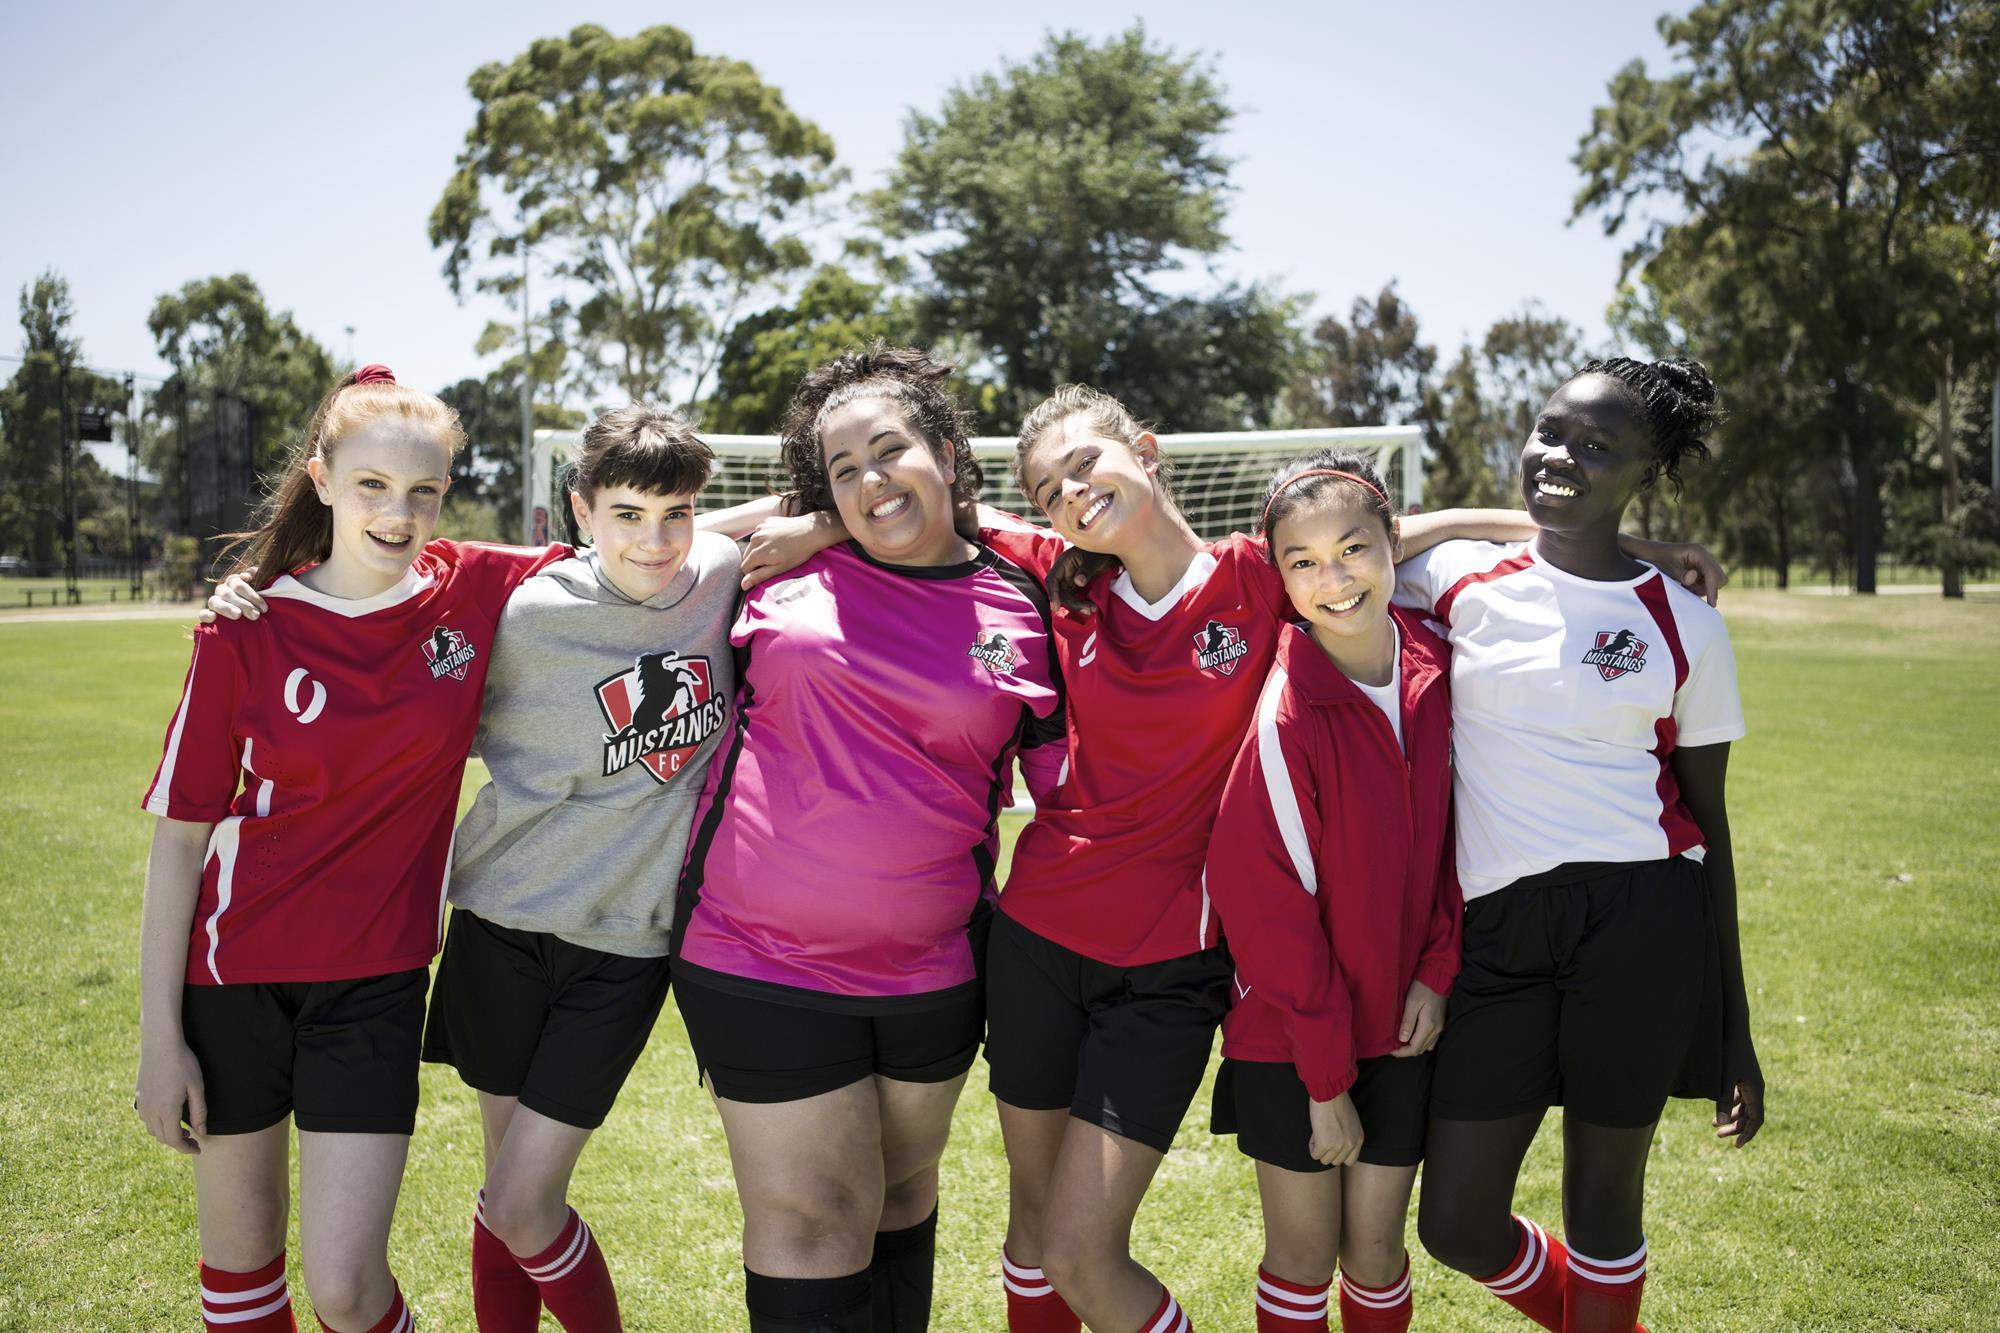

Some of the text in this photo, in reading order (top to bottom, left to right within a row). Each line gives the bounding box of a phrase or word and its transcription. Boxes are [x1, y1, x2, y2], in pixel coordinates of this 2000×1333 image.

[430, 644, 476, 679] MUSTANGS
[968, 646, 1015, 674] MUSTANGS
[1199, 640, 1248, 670] MUSTANGS
[1583, 651, 1646, 672] MUSTANGS
[454, 668, 464, 677] FC
[1221, 663, 1232, 672] FC
[1604, 666, 1616, 677] FC
[606, 695, 724, 775] MUSTANGS
[658, 753, 681, 773] FC
